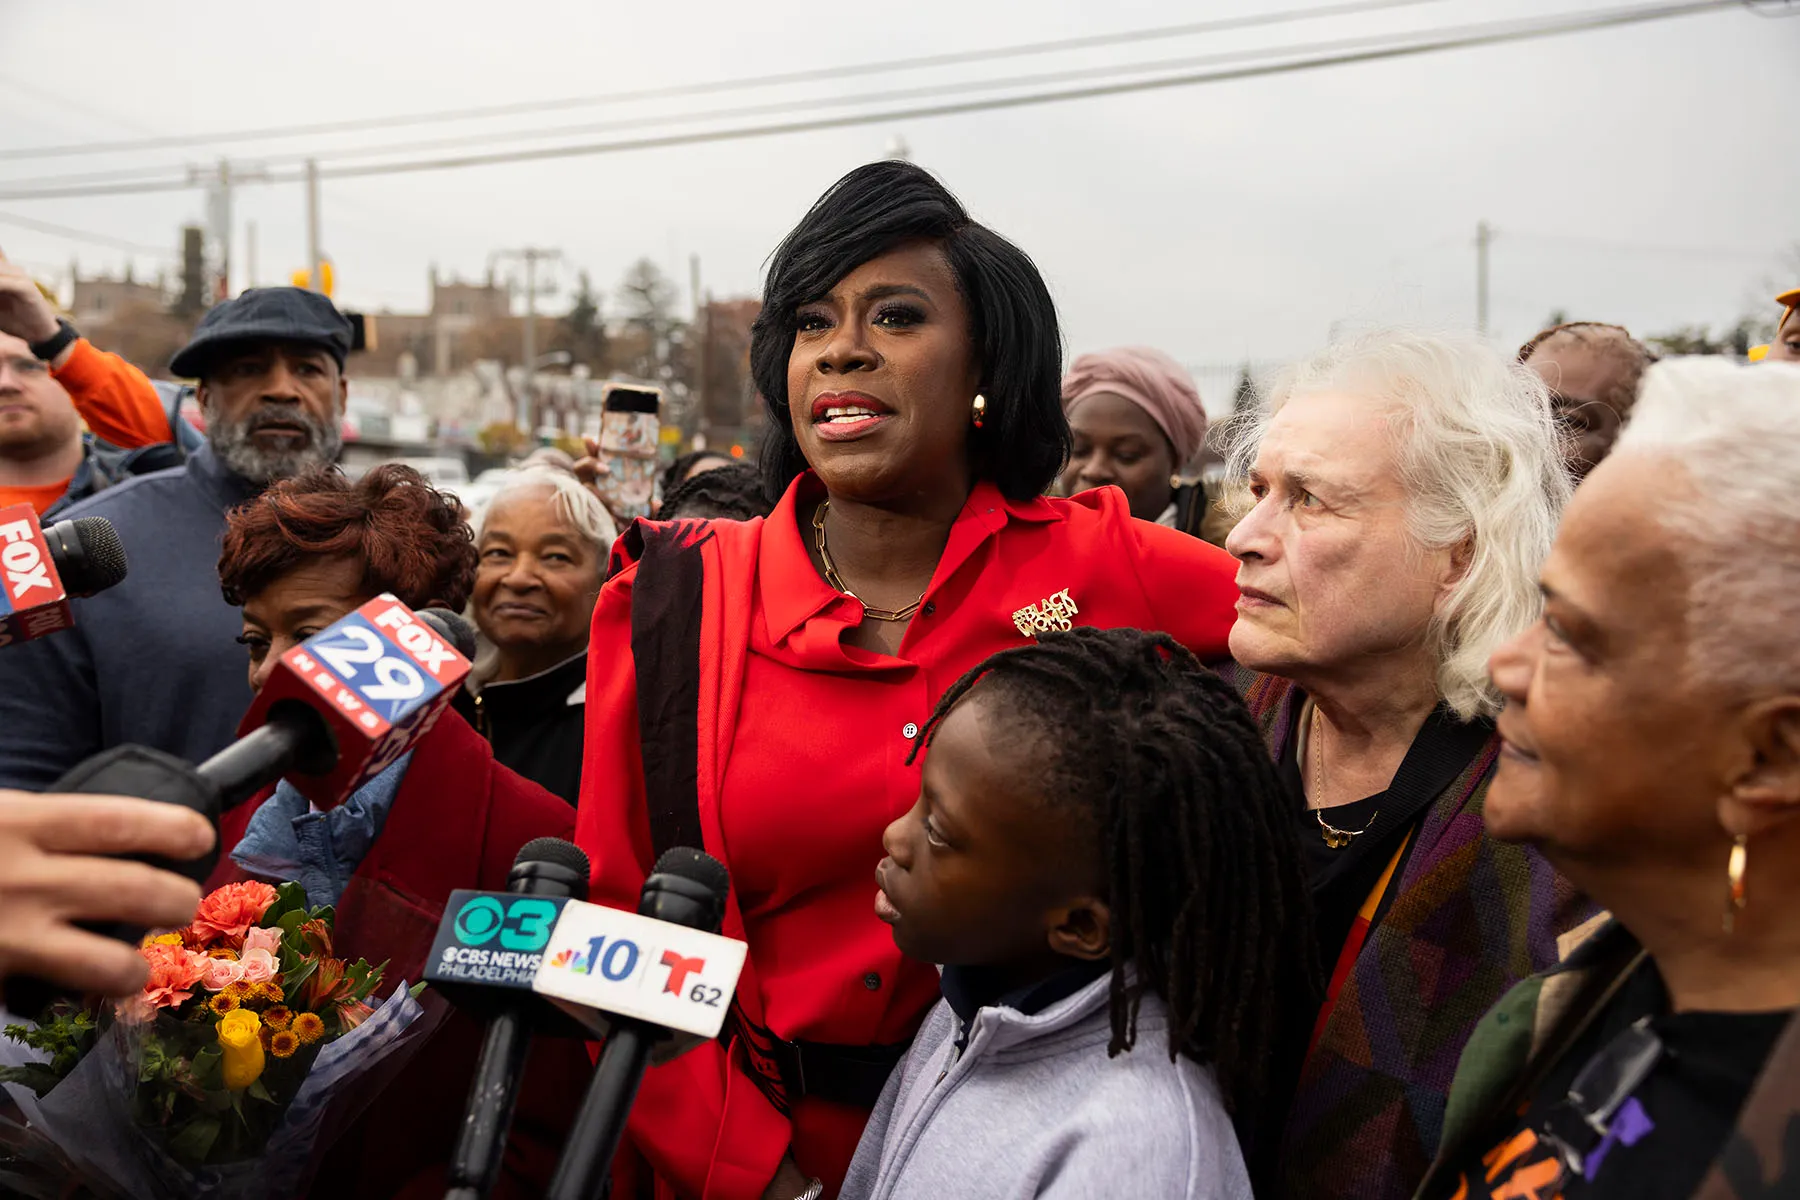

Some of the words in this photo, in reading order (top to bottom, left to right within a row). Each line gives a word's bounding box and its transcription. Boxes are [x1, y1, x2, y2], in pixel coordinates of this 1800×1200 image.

[0, 519, 53, 600] FOX
[374, 605, 457, 675] FOX
[1015, 599, 1078, 637] WOMEN
[292, 653, 379, 728] NEWS
[312, 625, 425, 700] 29
[456, 948, 490, 965] CBS
[490, 952, 542, 970] NEWS
[500, 900, 557, 951] 3
[438, 962, 536, 983] PHILADELPHIA
[587, 936, 639, 981] 10
[690, 984, 722, 1007] 62
